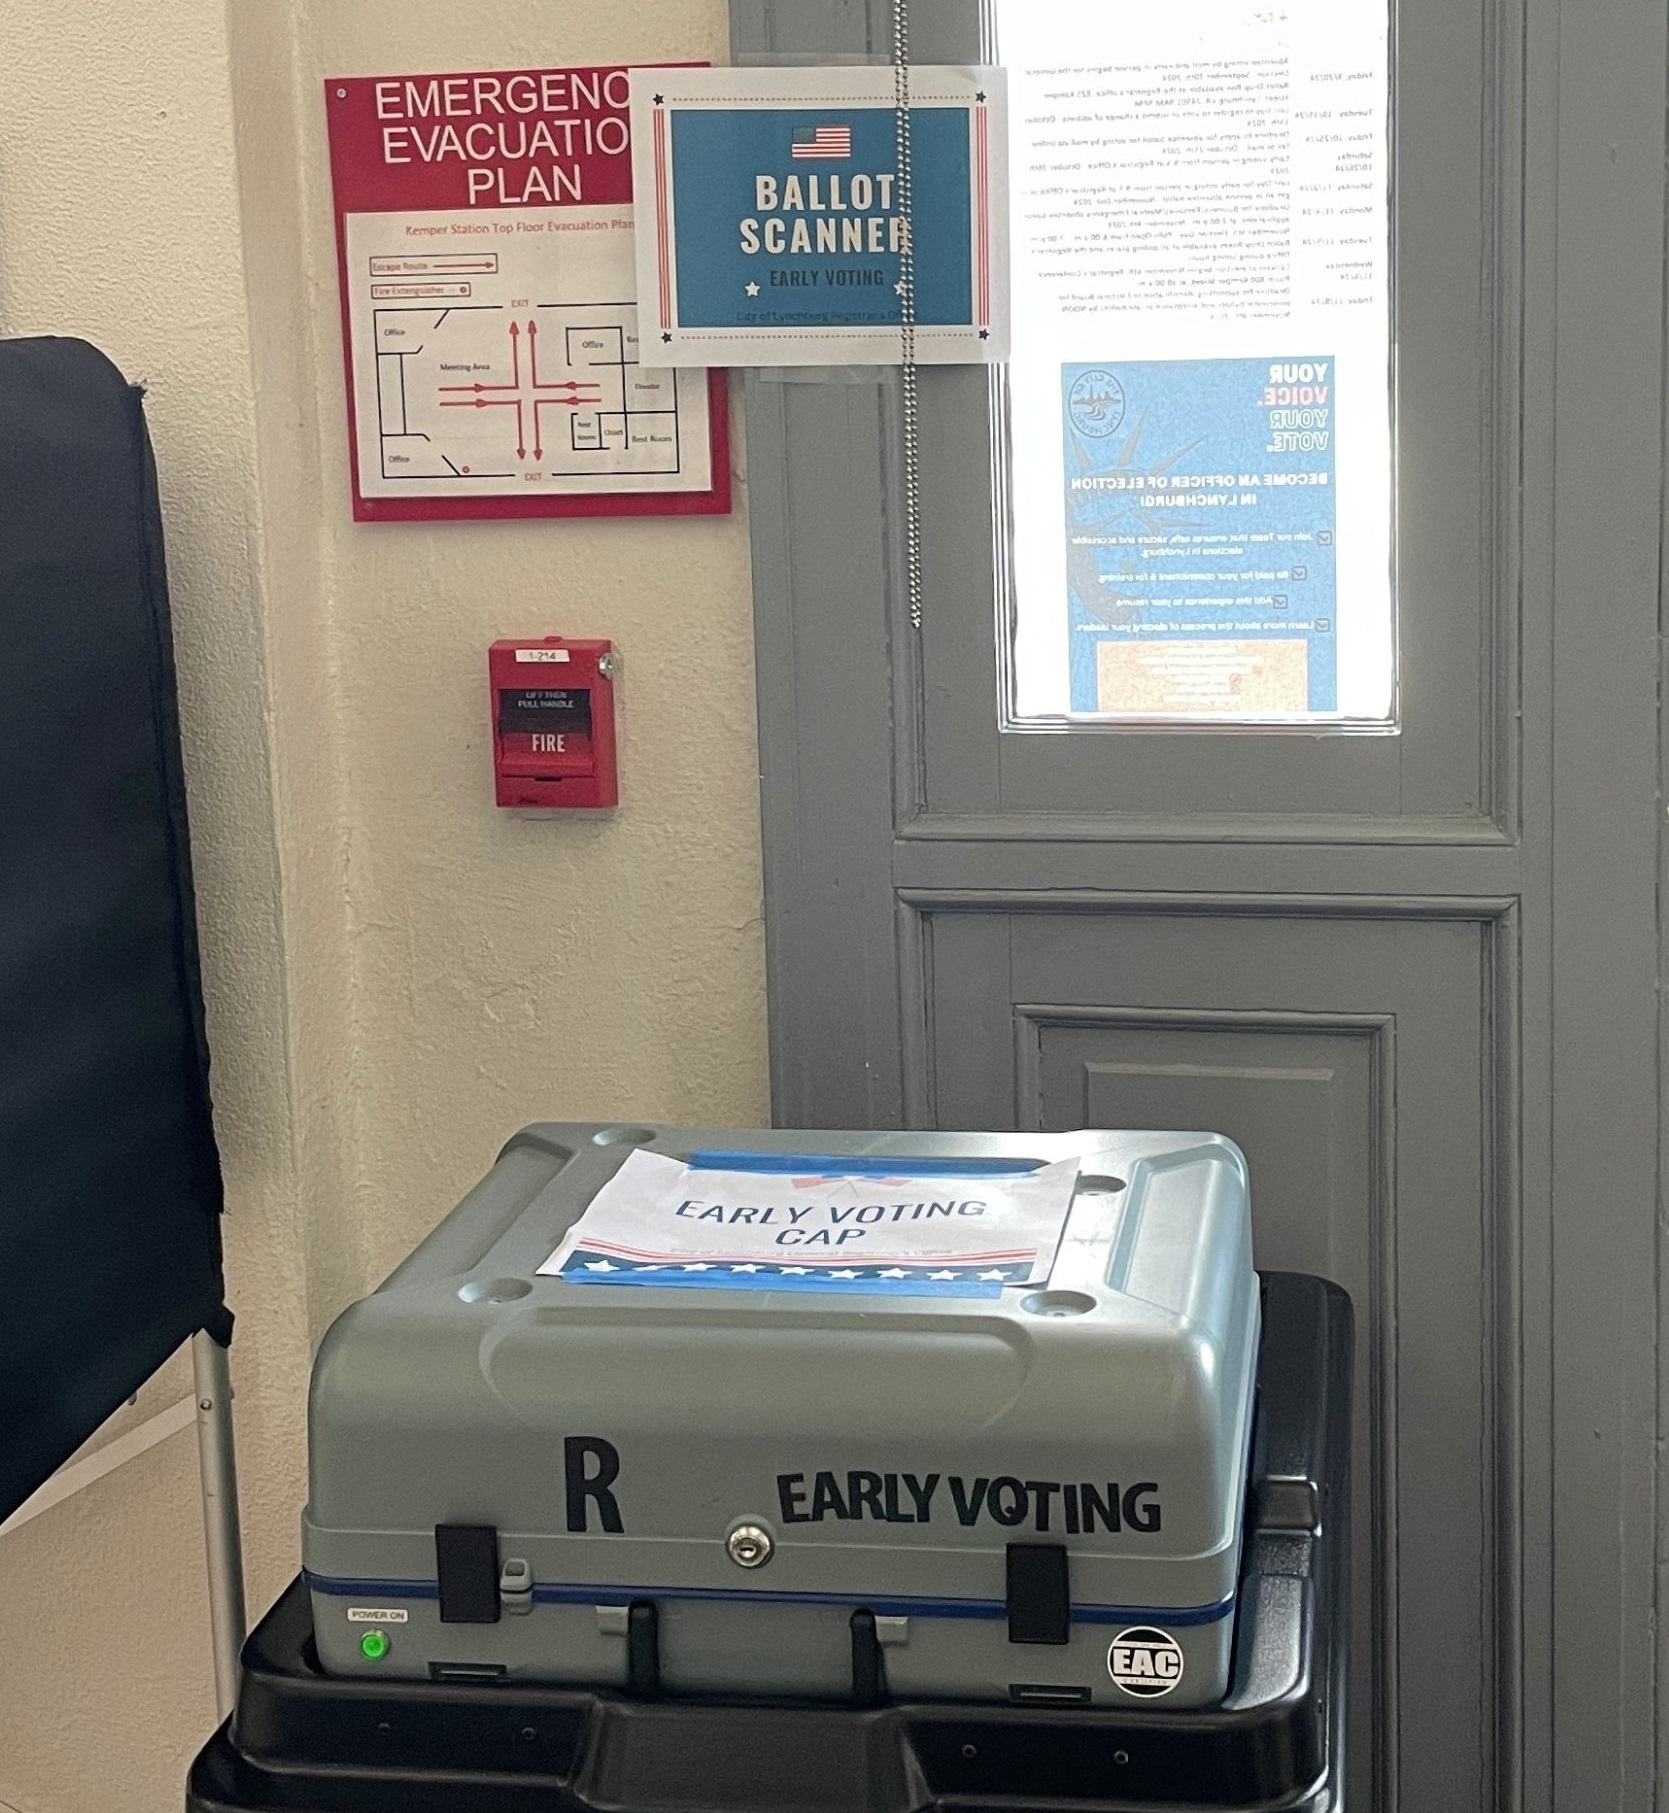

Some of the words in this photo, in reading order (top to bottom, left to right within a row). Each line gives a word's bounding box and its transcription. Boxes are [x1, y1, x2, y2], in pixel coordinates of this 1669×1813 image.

[374, 70, 629, 119] EMERGENC
[382, 117, 629, 164] EVACUATIO
[468, 164, 582, 204] PLAN
[755, 173, 895, 212] BALLOT
[406, 225, 447, 237] Kemper
[451, 223, 490, 234] Station
[493, 222, 514, 234] Top
[517, 221, 545, 232] Floor
[548, 220, 608, 232] Evacuation
[611, 219, 636, 230] Plan
[739, 216, 911, 255] SCANNER
[770, 269, 819, 288] EARLY
[826, 268, 885, 287] VOTING
[374, 286, 390, 296] Fire
[511, 300, 530, 309] EXIT
[384, 328, 406, 337] Office
[582, 340, 604, 349] Office
[440, 362, 468, 373] Meeting
[469, 362, 491, 371] Area
[388, 455, 411, 464] Office
[524, 472, 543, 482] EXIT
[532, 733, 566, 752] FIRE
[675, 1200, 811, 1225] EARLY
[828, 1200, 987, 1224] VOTING
[775, 1228, 867, 1246] CAP
[564, 1435, 625, 1534] R
[777, 1470, 941, 1524] EARLY
[352, 1610, 388, 1620] POWER
[390, 1611, 405, 1621] ON
[1112, 1647, 1180, 1678] EAC
